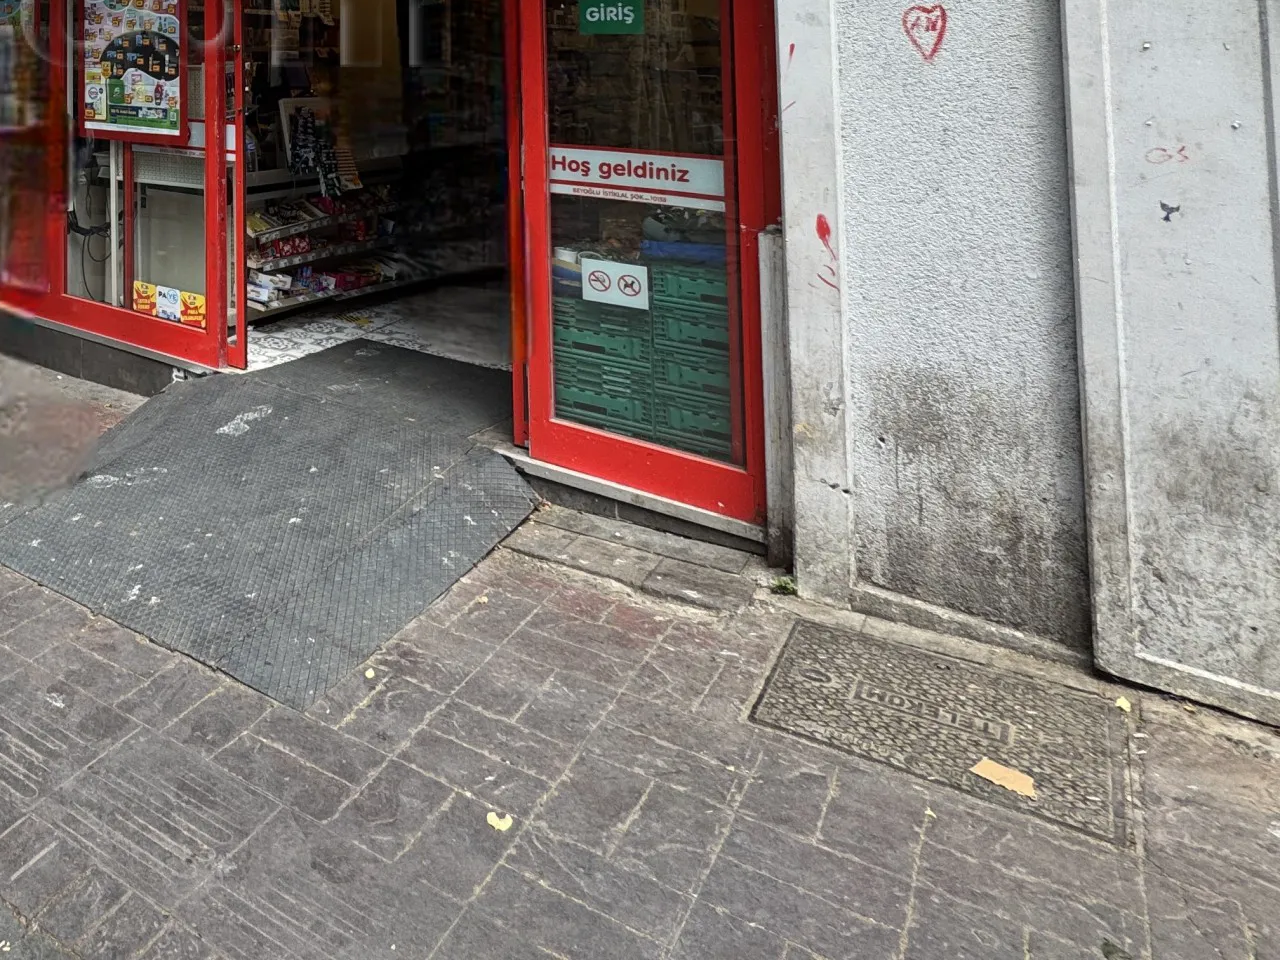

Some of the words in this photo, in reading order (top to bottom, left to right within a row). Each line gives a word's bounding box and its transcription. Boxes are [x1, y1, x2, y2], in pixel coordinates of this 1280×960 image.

[585, 2, 635, 24] GİRİŞ
[551, 154, 591, 177] Hoş
[598, 159, 690, 183] geldiniz
[572, 186, 601, 196] BEYOĞLU
[865, 686, 992, 736] TELEKOM
